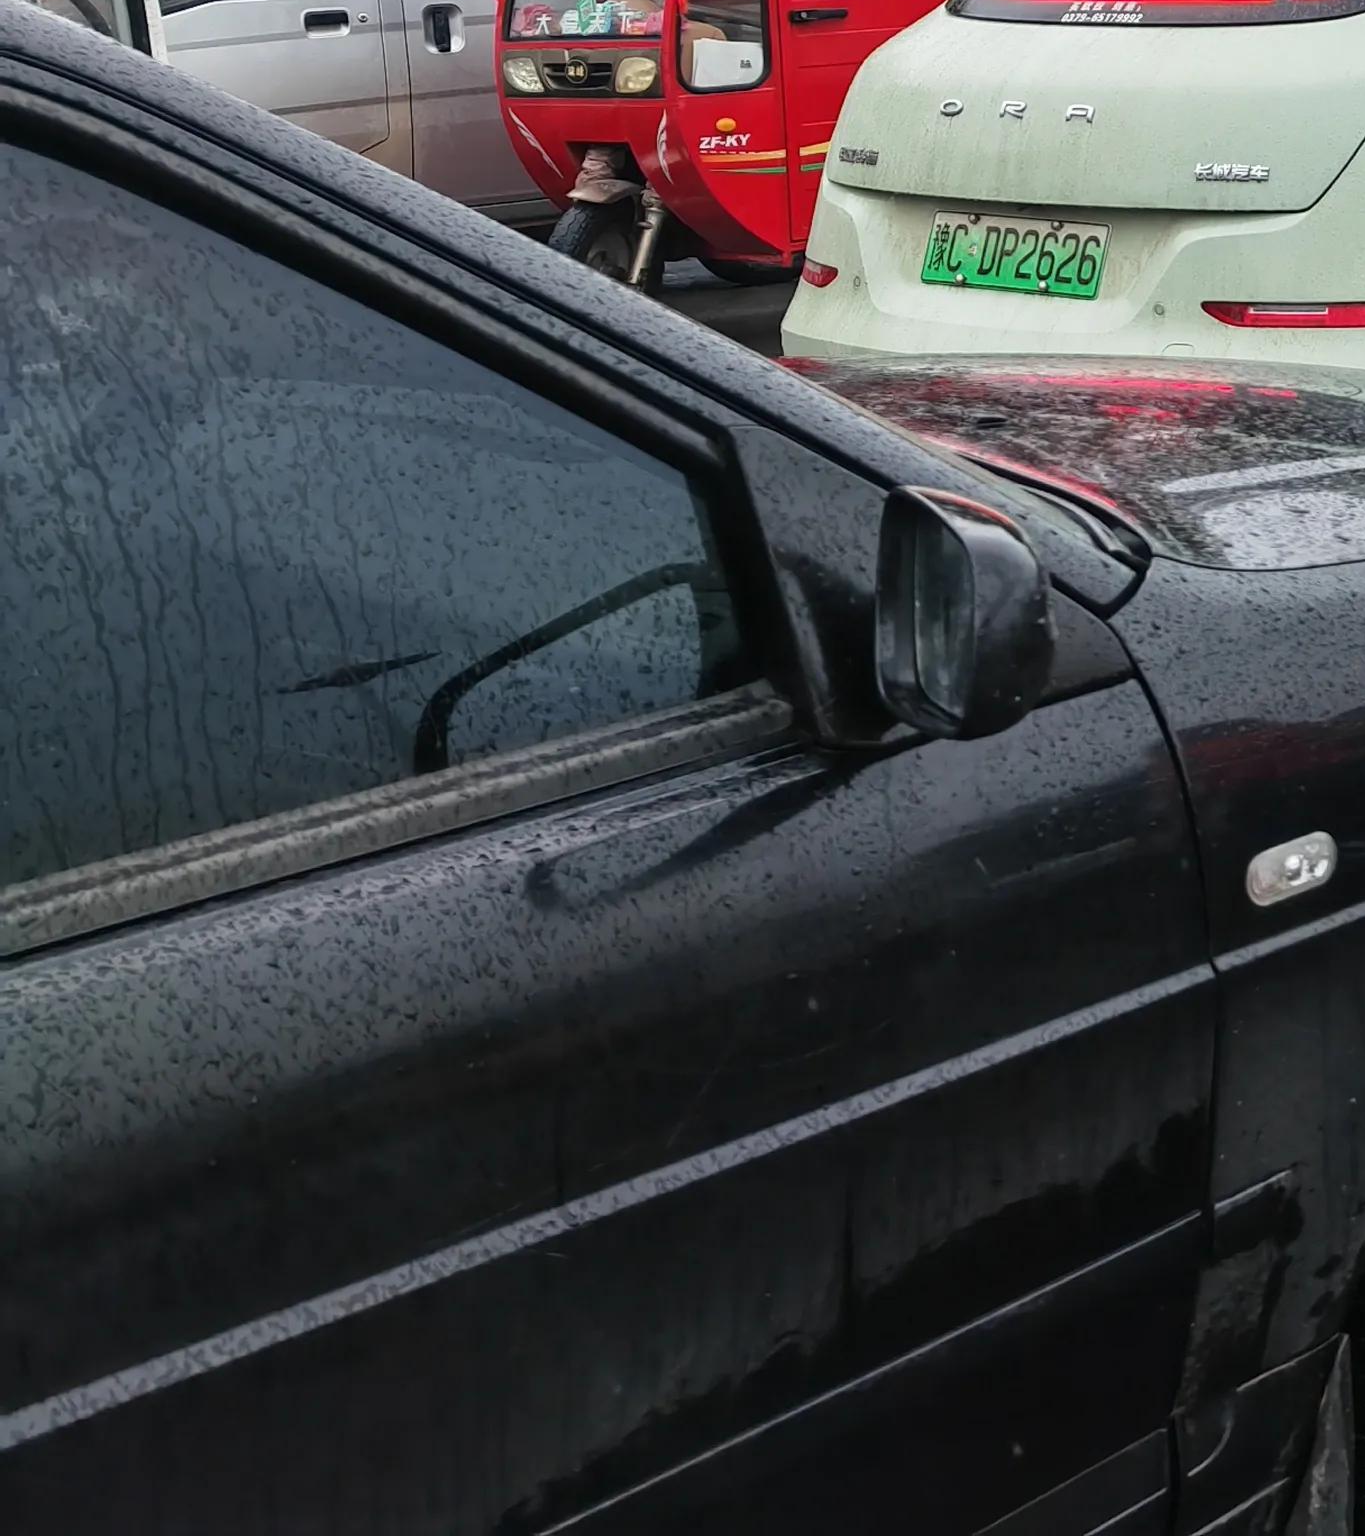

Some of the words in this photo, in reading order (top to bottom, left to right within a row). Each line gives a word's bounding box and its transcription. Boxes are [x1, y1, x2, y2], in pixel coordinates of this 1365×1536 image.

[940, 99, 1096, 123] ORA
[699, 133, 751, 149] ZF-KY
[1193, 163, 1270, 183] 长城汽车
